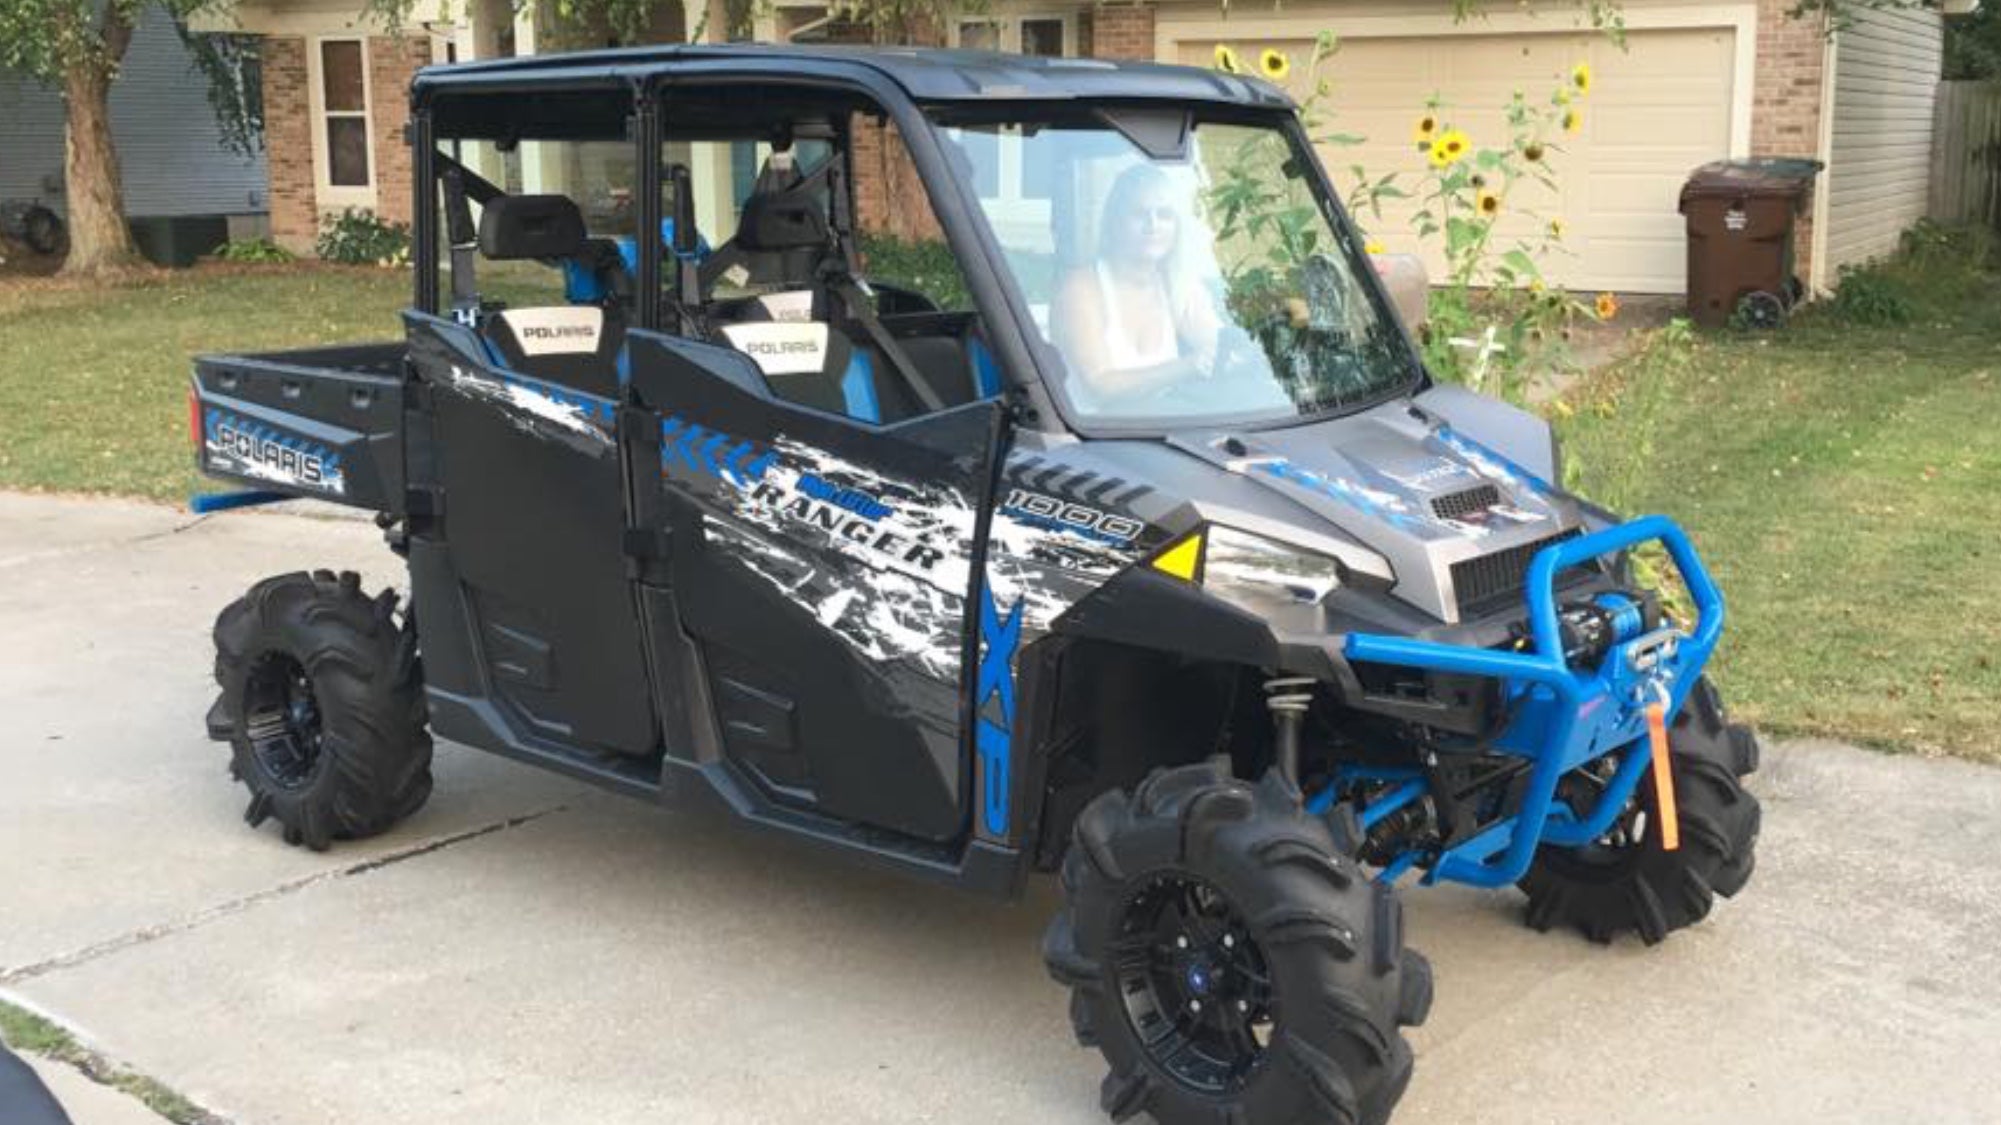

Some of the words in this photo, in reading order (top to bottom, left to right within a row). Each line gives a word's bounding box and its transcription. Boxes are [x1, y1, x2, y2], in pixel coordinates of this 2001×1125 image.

[522, 325, 596, 338] POLARIS
[747, 341, 819, 354] POLARIS
[217, 424, 324, 483] POLARIS
[752, 481, 945, 569] RANGER
[1005, 489, 1144, 541] 1000
